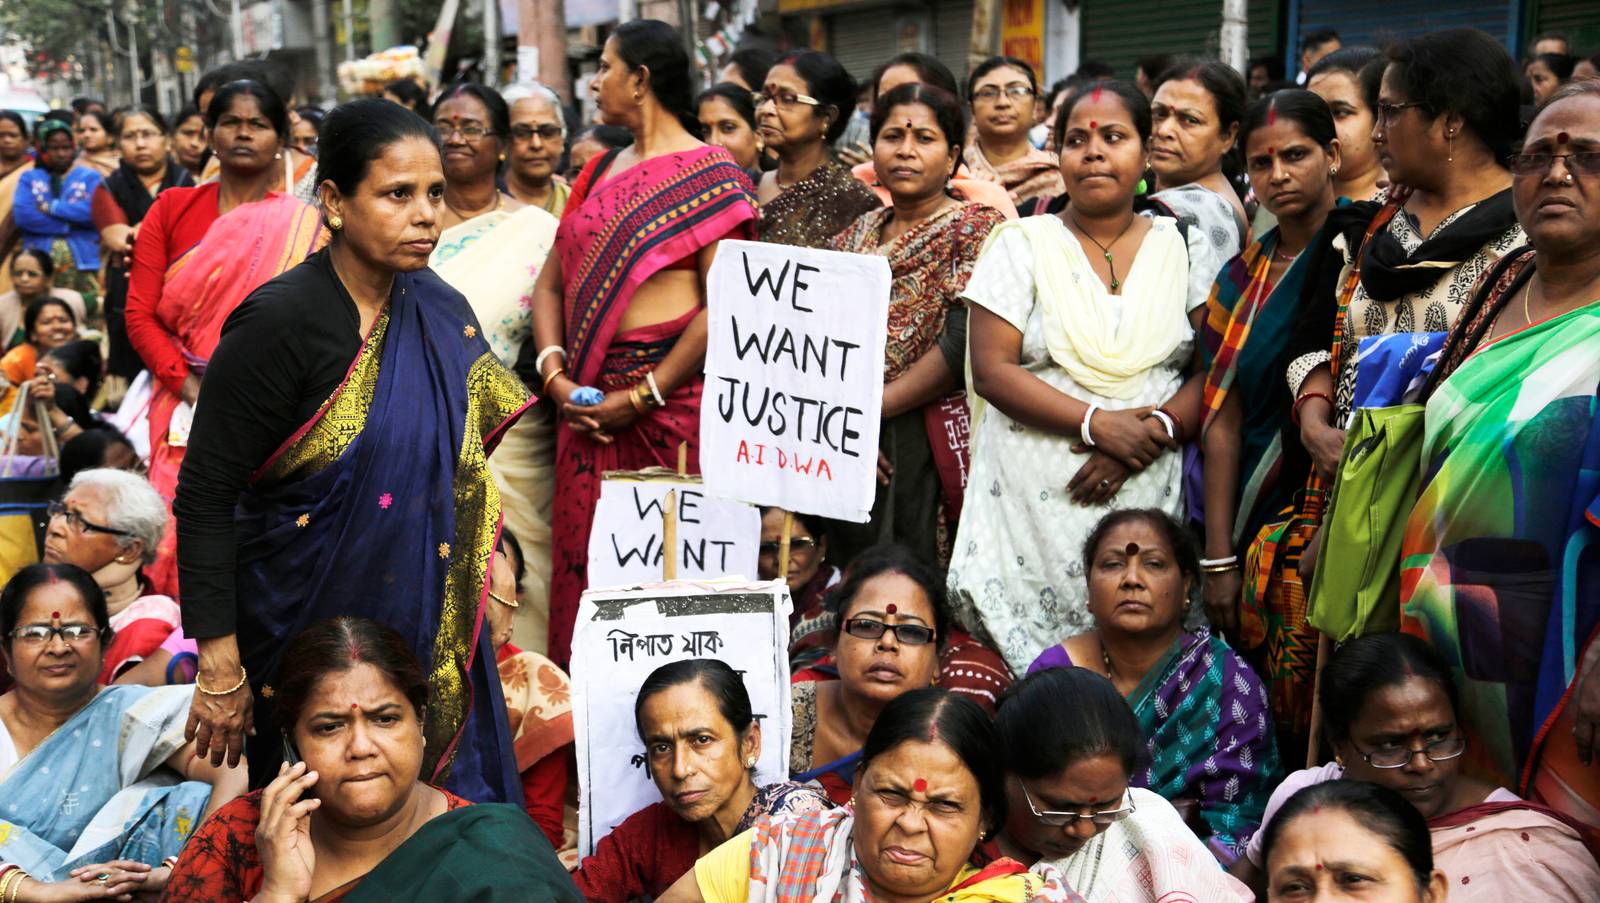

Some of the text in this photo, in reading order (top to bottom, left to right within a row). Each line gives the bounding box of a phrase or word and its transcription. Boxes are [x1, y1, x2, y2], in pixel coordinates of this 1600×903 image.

[742, 251, 821, 313] WE
[731, 314, 861, 382] WANT
[717, 375, 864, 458] JUSTICE
[632, 486, 705, 524] WE
[606, 628, 724, 662] নিপাত যাক
